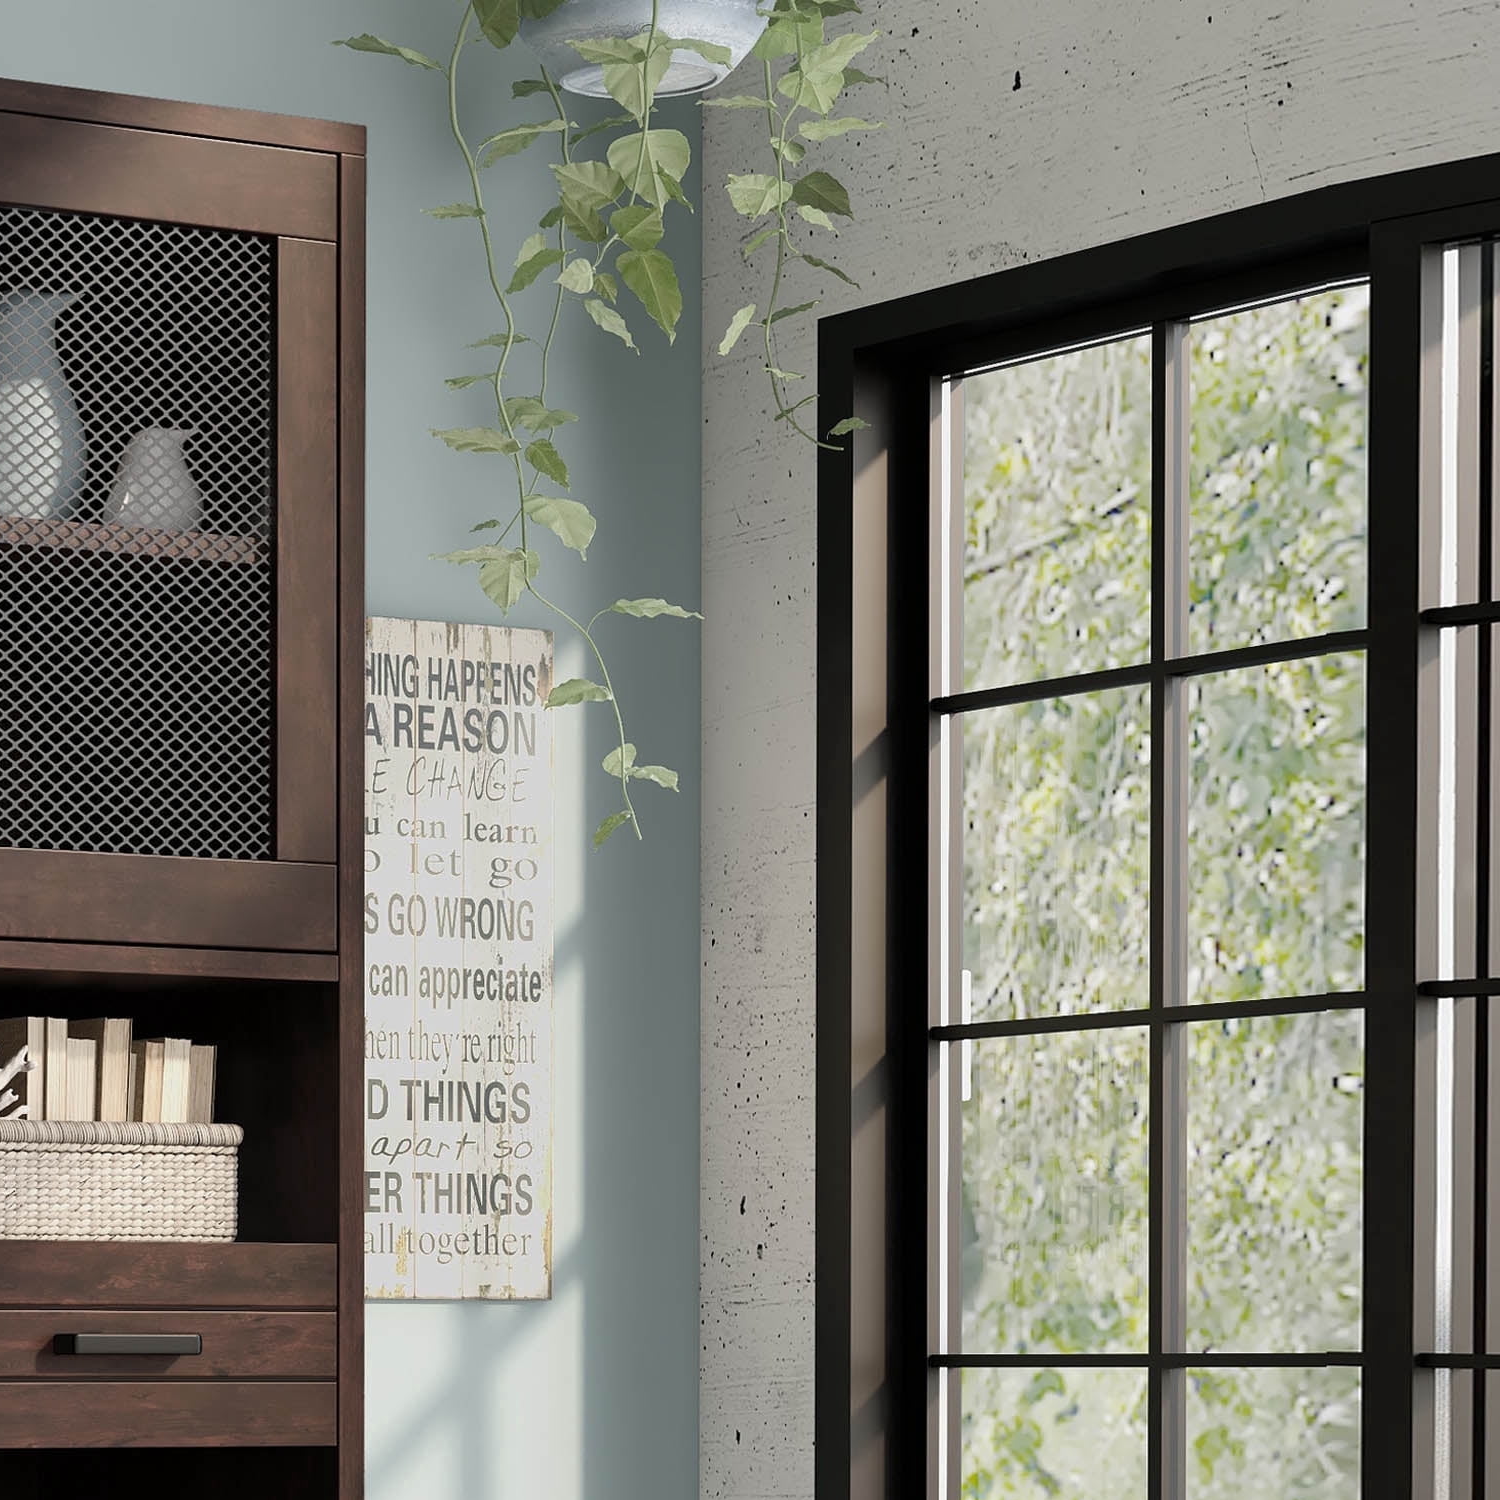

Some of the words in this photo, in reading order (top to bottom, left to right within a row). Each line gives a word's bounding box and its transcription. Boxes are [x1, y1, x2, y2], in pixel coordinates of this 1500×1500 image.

[427, 656, 536, 706] HAPPENS
[365, 702, 382, 746] A
[393, 703, 536, 757] REASON
[406, 756, 530, 802] CHANGE
[397, 817, 447, 839] can
[463, 812, 538, 844] learn
[410, 842, 462, 877] let
[489, 855, 538, 889] go
[388, 893, 427, 937] GO
[434, 896, 534, 942] WRONG
[369, 963, 408, 997] can
[419, 957, 542, 1009] appreciate
[408, 1019, 481, 1075] they're
[487, 1021, 537, 1076] right
[368, 1079, 389, 1120] D
[399, 1079, 531, 1124] THINGS
[371, 1133, 476, 1165] apart
[493, 1138, 533, 1160] so
[365, 1171, 403, 1214] ER
[412, 1171, 533, 1216] THINGS
[365, 1222, 394, 1255] all
[405, 1223, 532, 1264] together
